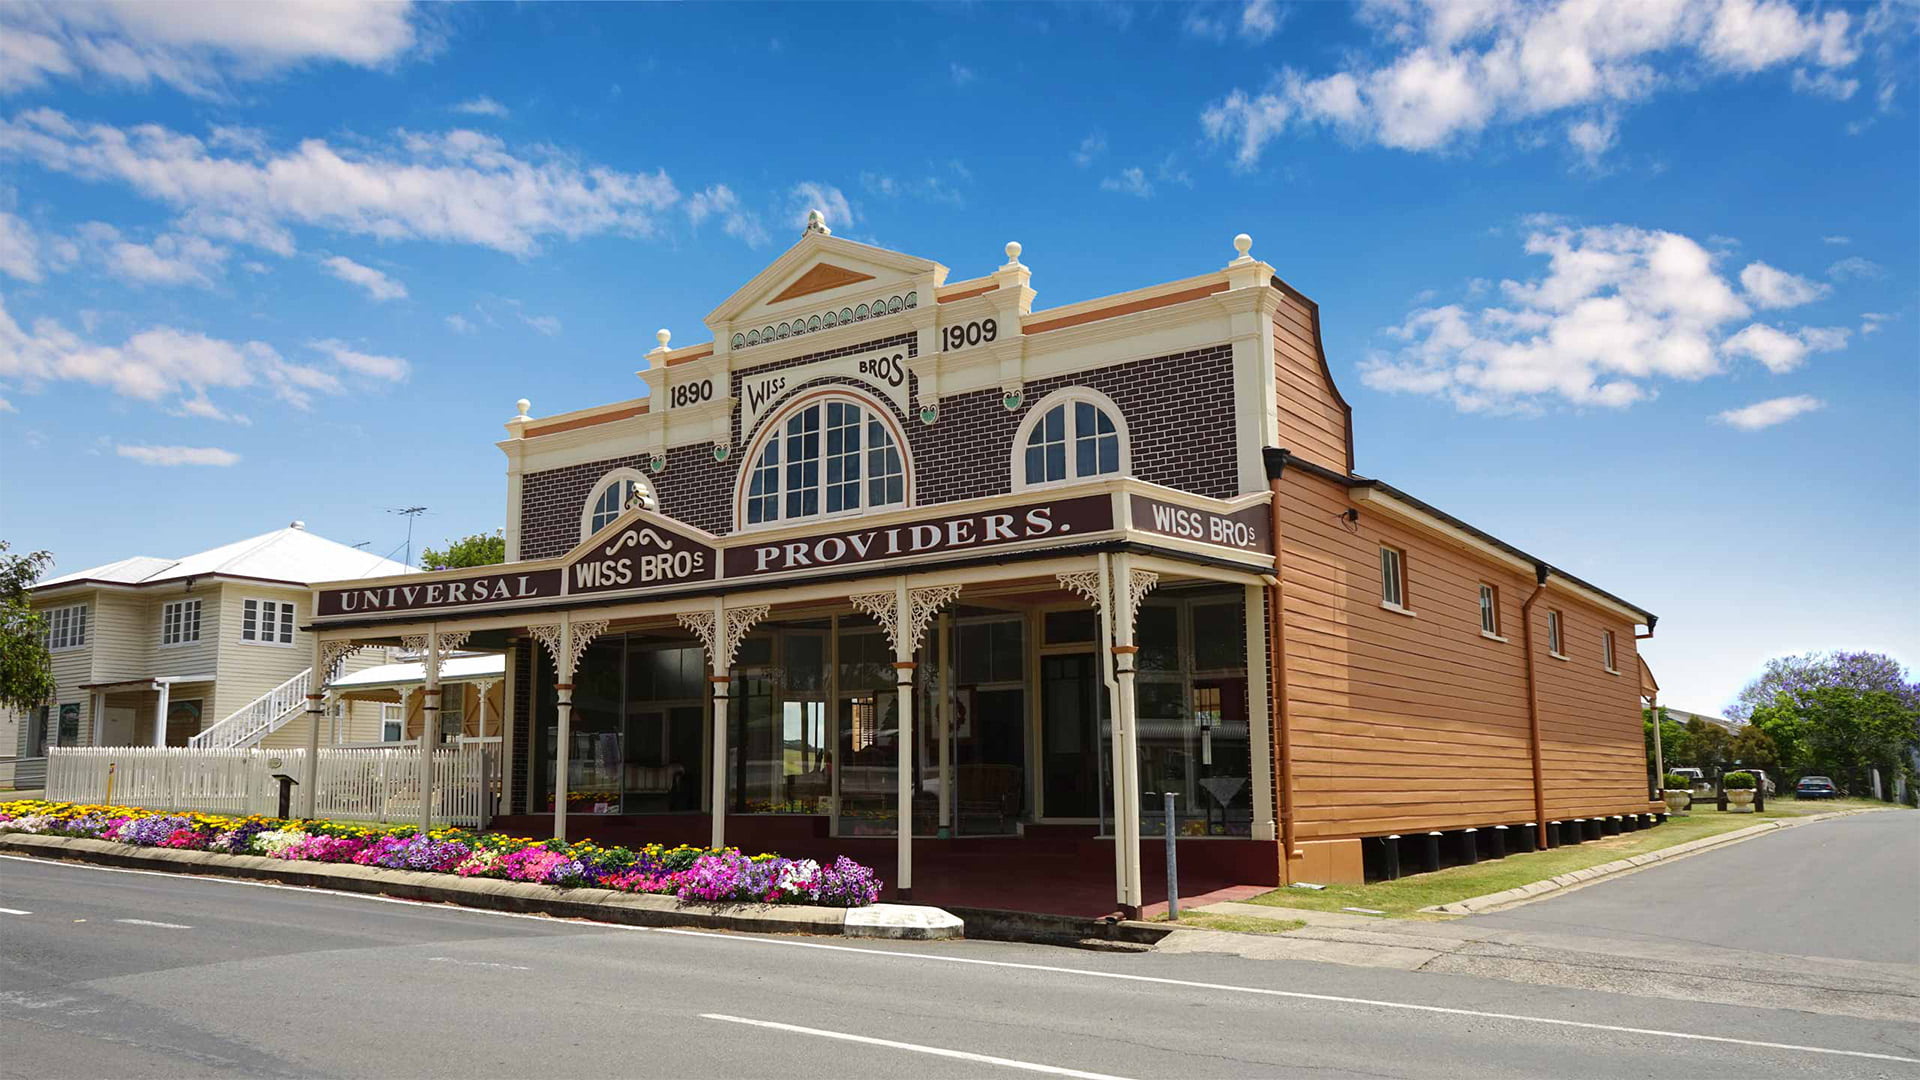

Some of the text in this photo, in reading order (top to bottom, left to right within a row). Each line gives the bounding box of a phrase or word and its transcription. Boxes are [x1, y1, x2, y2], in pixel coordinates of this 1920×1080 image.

[942, 318, 998, 352] 1909
[859, 353, 904, 387] BROS
[671, 379, 713, 409] 1890
[1152, 504, 1204, 539] WISS
[754, 507, 1072, 572] PROVIDERS.
[576, 557, 633, 589] WISS
[340, 576, 538, 612] UNIVERSAL
